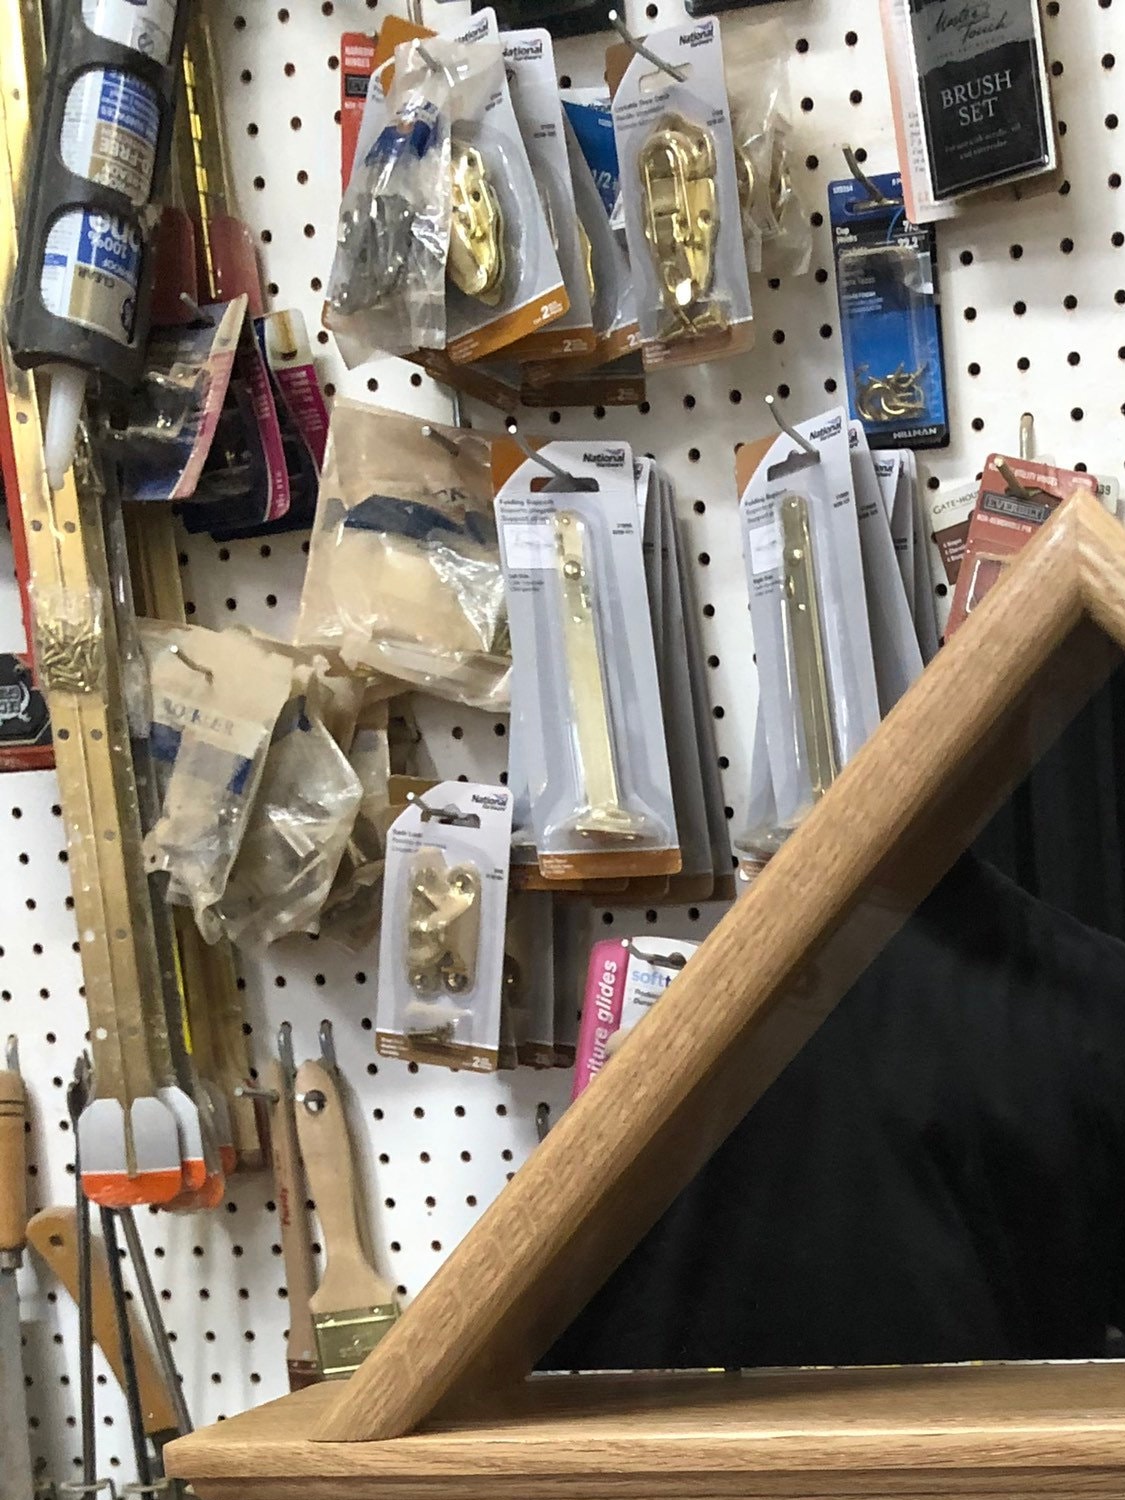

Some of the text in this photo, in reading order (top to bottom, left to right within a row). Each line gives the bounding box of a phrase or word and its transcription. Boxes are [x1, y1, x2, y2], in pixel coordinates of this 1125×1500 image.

[680, 28, 714, 46] National
[941, 69, 1013, 109] BRUSH
[958, 97, 999, 126] SET
[808, 419, 843, 440] National
[893, 427, 938, 439] HILLMAN
[583, 450, 626, 463] National
[471, 793, 508, 807] National
[596, 960, 618, 1025] glides
